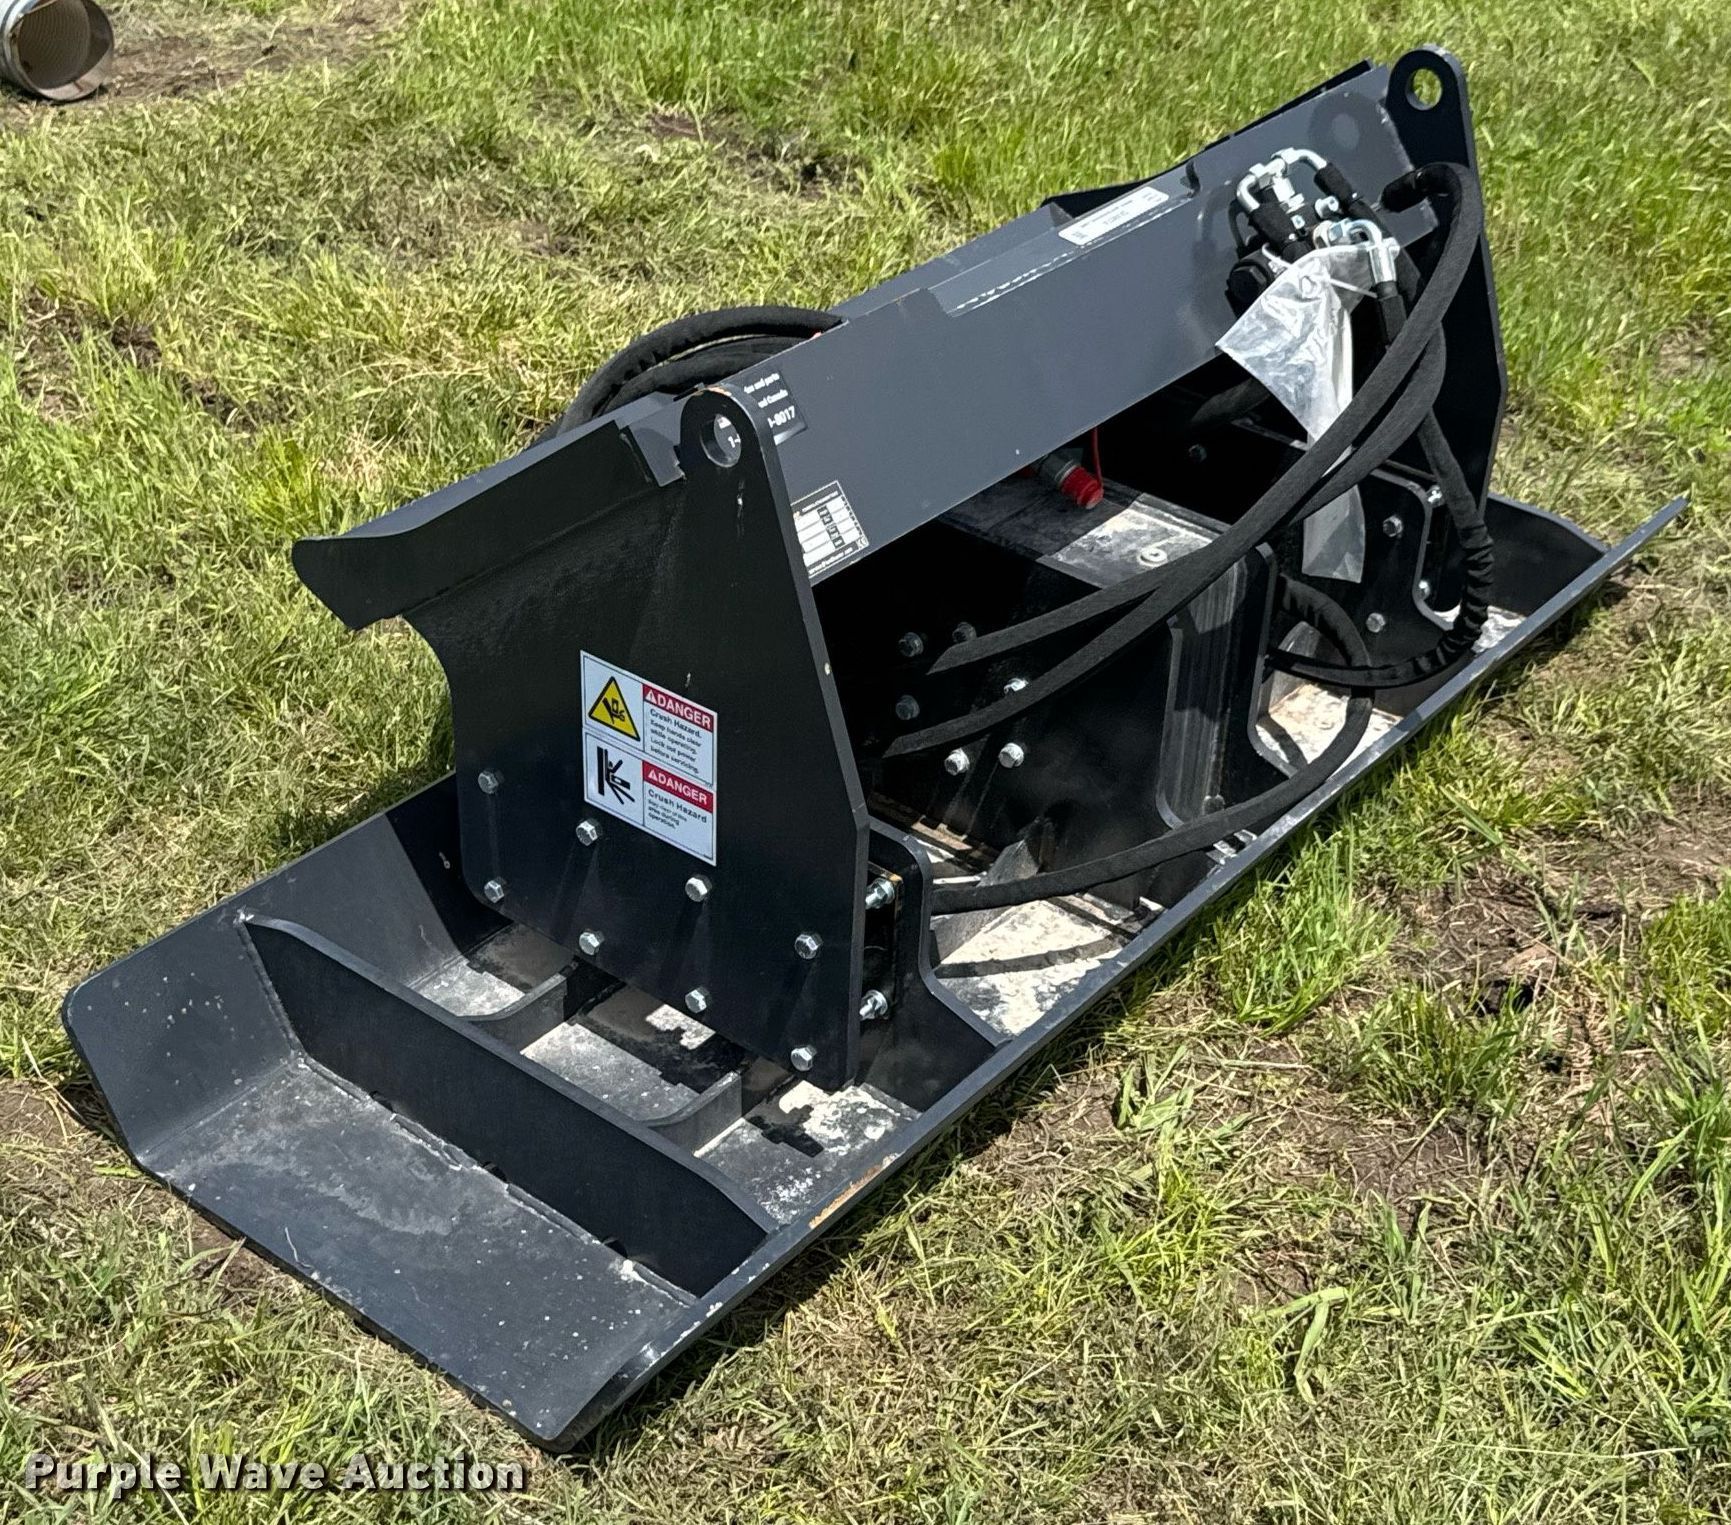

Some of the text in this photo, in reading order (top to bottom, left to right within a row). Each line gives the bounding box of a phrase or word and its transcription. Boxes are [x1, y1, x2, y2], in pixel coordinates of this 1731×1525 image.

[767, 389, 789, 405] Canada
[650, 708, 673, 724] Crush
[657, 694, 711, 729] DANGER
[667, 726, 686, 740] hands
[677, 750, 697, 762] power
[659, 772, 708, 805] DANGER
[648, 789, 707, 823] Crush Hazard
